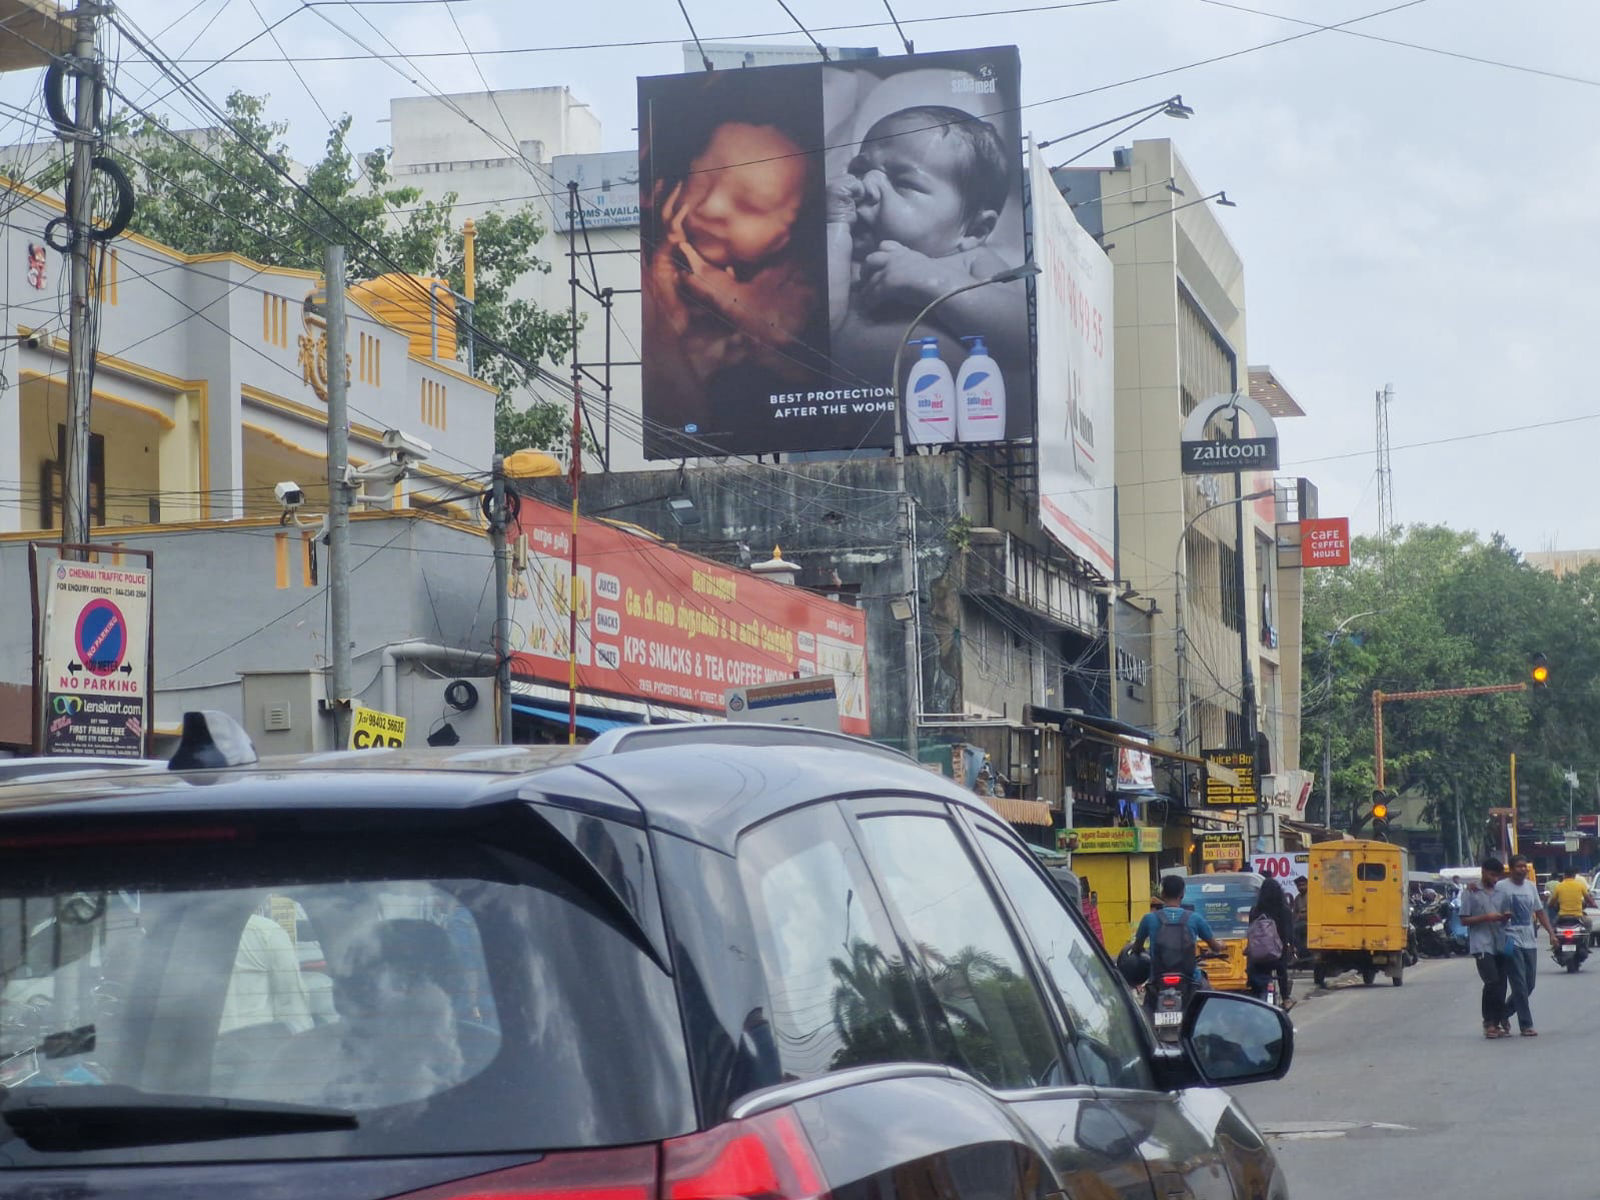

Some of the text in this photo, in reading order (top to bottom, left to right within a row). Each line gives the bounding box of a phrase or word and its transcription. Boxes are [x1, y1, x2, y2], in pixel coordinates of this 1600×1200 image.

[770, 387, 894, 404] BEST PROTECTION
[774, 401, 895, 418] AFTER THE WOMB
[1193, 441, 1266, 460] zaitoon
[1311, 540, 1345, 550] COFFEE
[1312, 550, 1341, 559] HOUSE
[68, 568, 146, 584] CHENNAI TRAFFIC POLICE
[56, 583, 67, 591] FOR
[68, 584, 89, 593] ENQUIRY
[90, 586, 112, 595] CONTACT
[598, 579, 618, 595] JUICES
[597, 613, 619, 629] SNACKS
[87, 615, 119, 657] NO PARKING
[624, 635, 647, 665] KPS
[649, 641, 692, 676] SNACKS
[694, 652, 703, 677] &
[704, 654, 725, 682] TEA
[726, 659, 762, 685] COFFEE
[60, 676, 138, 693] NO PARKING
[83, 699, 142, 715] lenskart.com
[69, 725, 126, 736] FIRST FRAME FREE
[1254, 857, 1290, 878] 700
